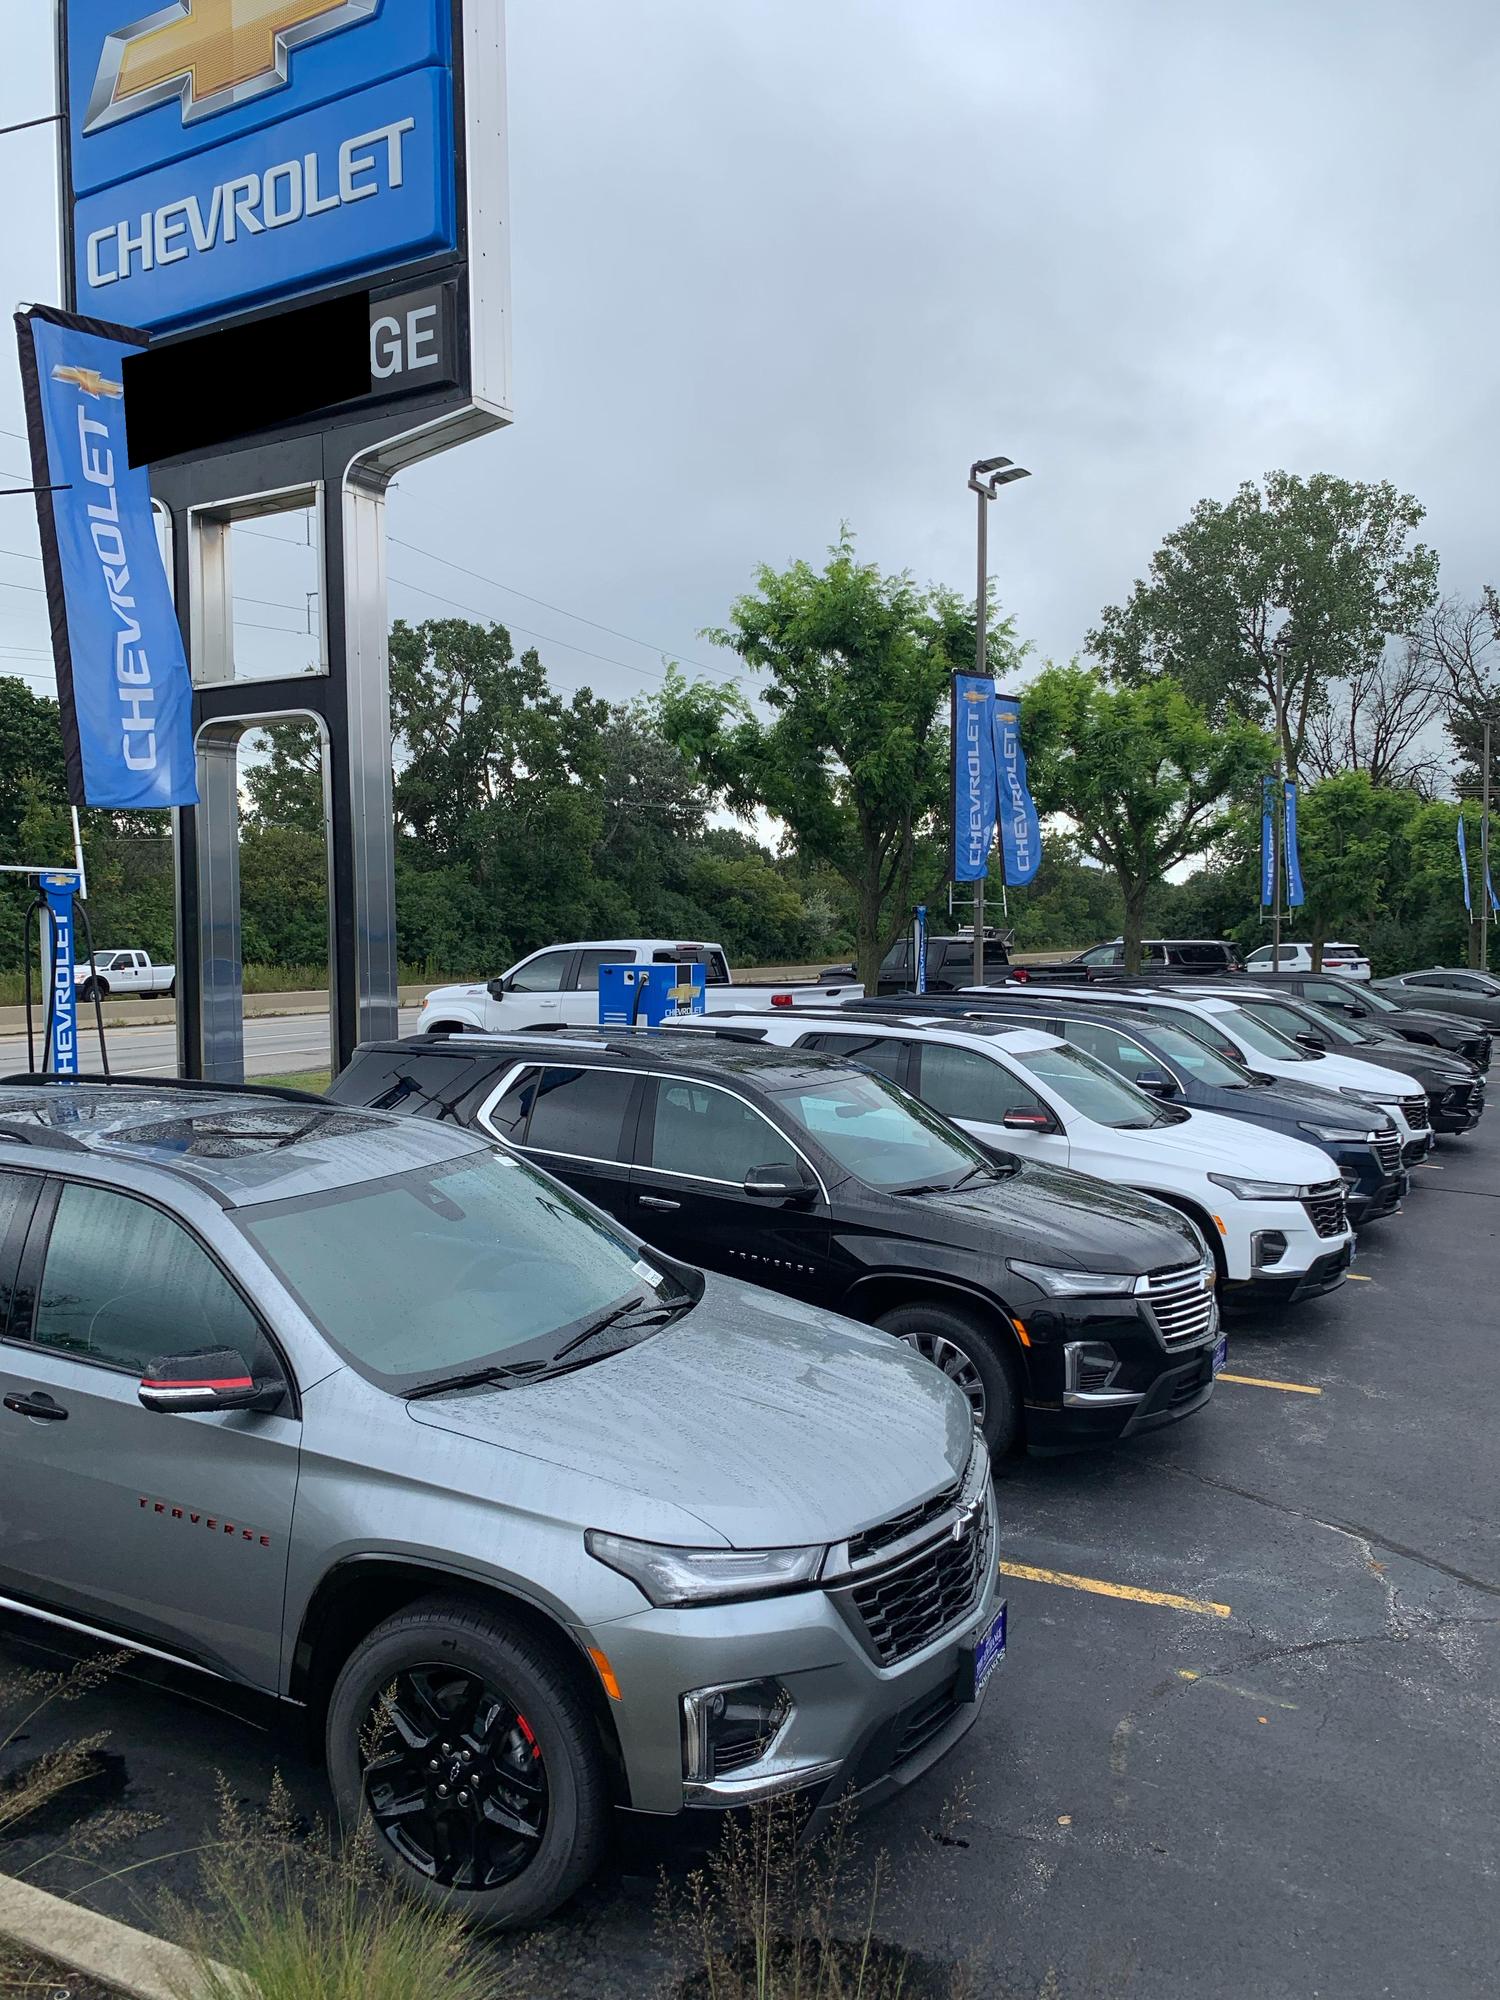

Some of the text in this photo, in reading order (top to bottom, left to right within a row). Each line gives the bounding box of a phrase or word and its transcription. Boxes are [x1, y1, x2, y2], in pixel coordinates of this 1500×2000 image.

[87, 117, 415, 287] CHEVROLET
[78, 405, 156, 771] CHEVROLET
[967, 708, 980, 866] CHEVROLET
[1003, 728, 1029, 872] CHEVROLET
[53, 910, 73, 1074] HEVROLET
[664, 1006, 703, 1017] CHEVROLET
[138, 1498, 270, 1547] TRAVERSE
